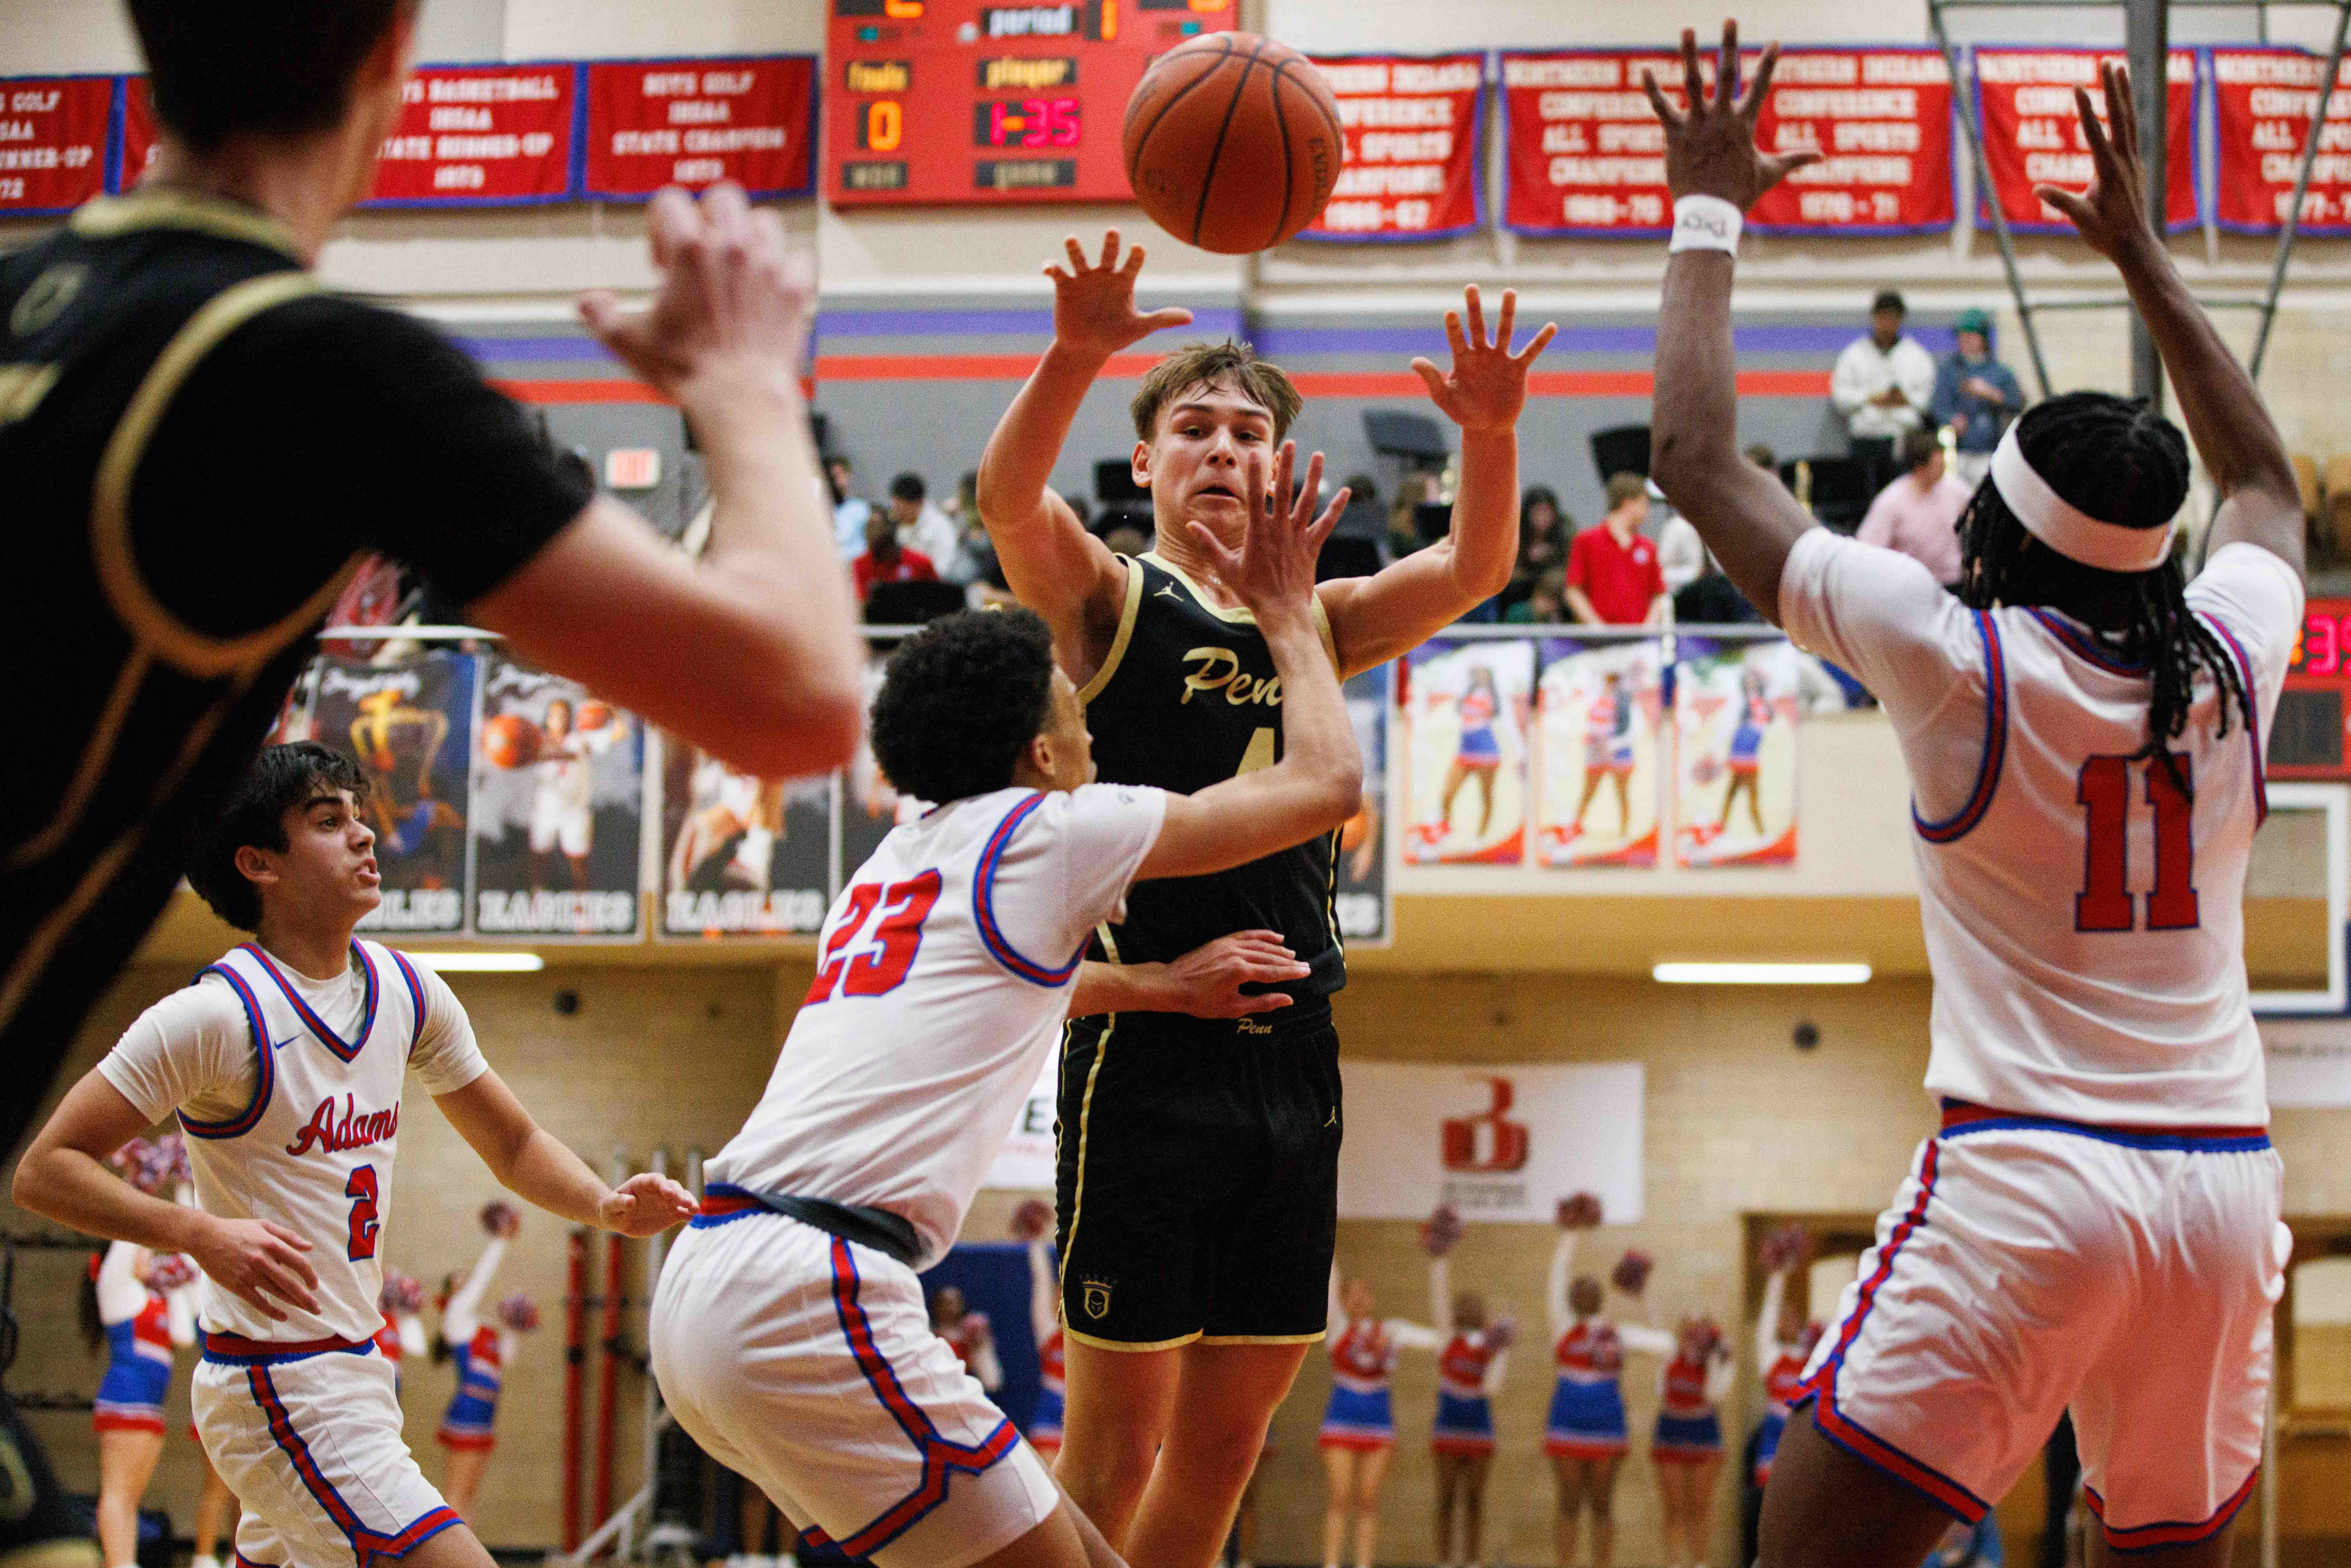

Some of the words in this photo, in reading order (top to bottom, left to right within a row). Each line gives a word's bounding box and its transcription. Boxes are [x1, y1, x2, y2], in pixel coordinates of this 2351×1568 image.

[377, 138, 431, 159] TATE
[868, 101, 902, 151] 0
[1182, 646, 1283, 706] Pen
[2075, 752, 2200, 932] 11
[800, 868, 943, 1010] 23
[286, 1092, 399, 1157] Adams
[344, 1163, 380, 1262] 2
